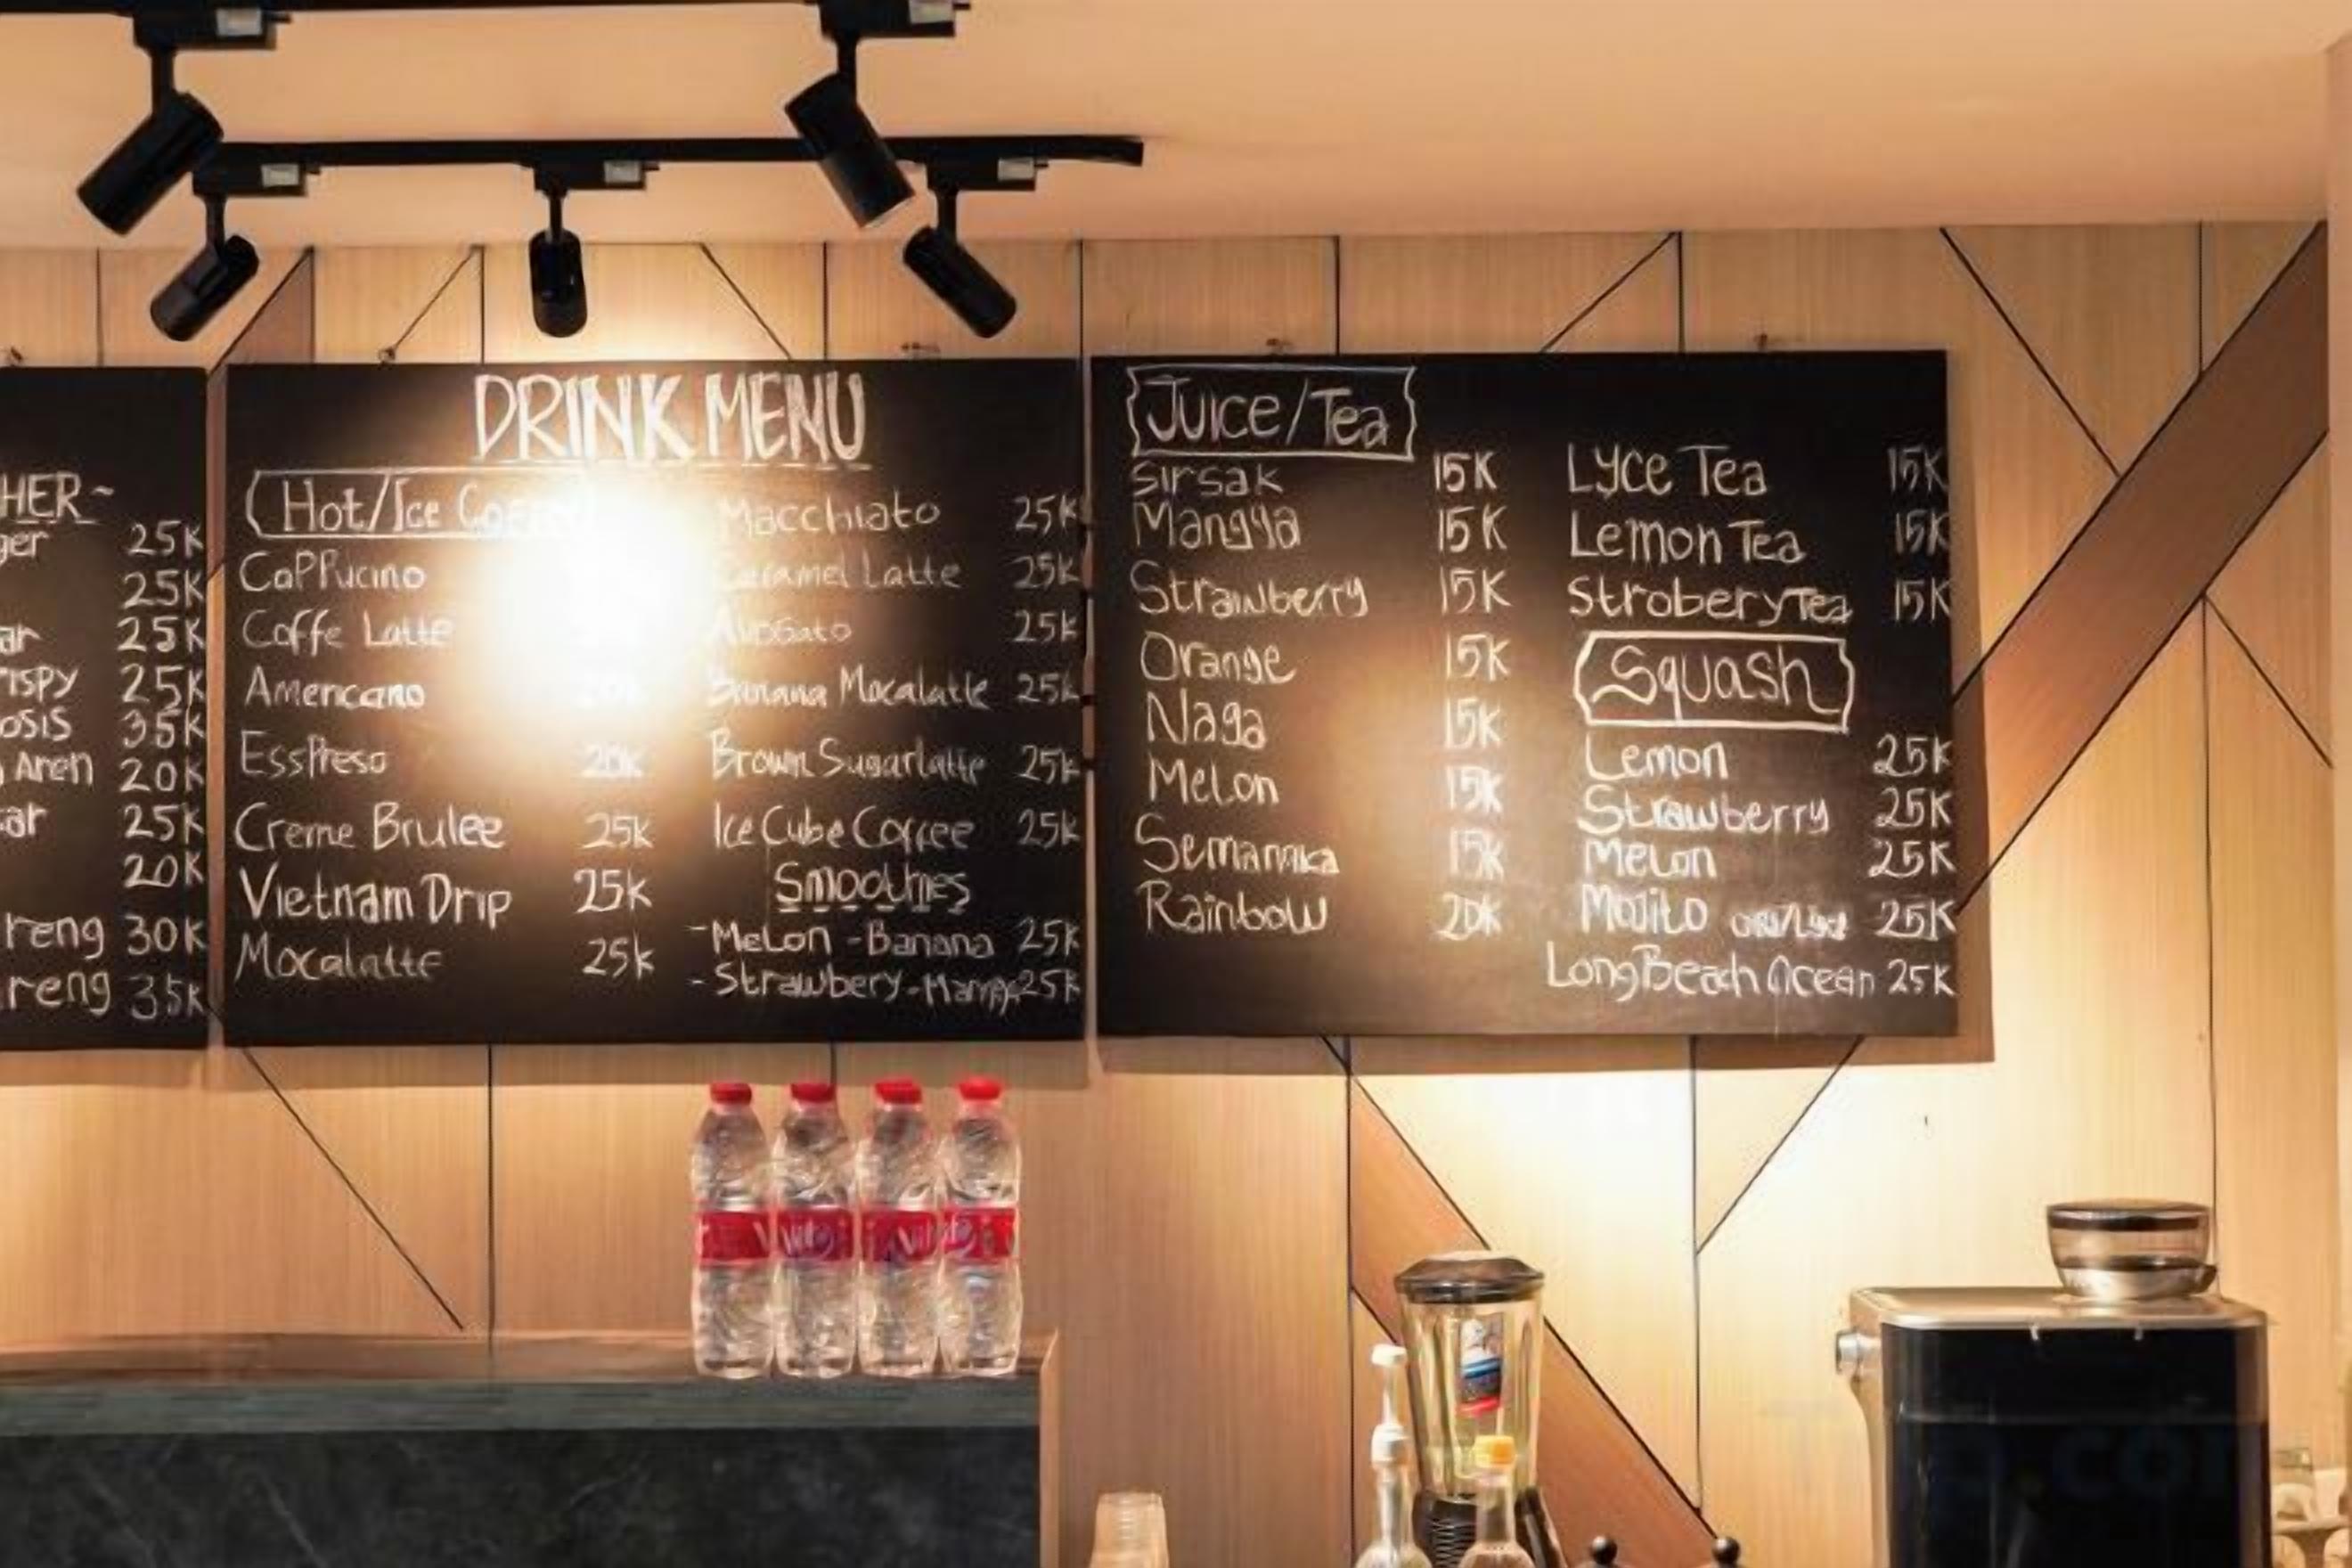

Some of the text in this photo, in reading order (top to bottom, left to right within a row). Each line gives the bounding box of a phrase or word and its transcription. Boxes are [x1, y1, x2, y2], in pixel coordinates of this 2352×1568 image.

[473, 371, 869, 461] DRINK MENU
[1433, 451, 1498, 492] 15K
[1677, 445, 1768, 496] Tea
[126, 519, 203, 558] 25K
[1439, 504, 1507, 552] 15K
[1571, 510, 1722, 567] Lemon
[1728, 519, 1809, 564] Tea
[122, 569, 203, 608] 25K
[1440, 567, 1513, 614] 15K
[117, 617, 204, 653] 25K
[1140, 632, 1511, 684] Orange 15K
[120, 664, 204, 710] 25K
[1591, 645, 1841, 723] Squash
[1147, 688, 1268, 751] Naga
[120, 757, 204, 792] 20K
[1586, 734, 1728, 780] Lemon
[124, 803, 204, 844] 25K
[234, 802, 354, 852] Creme
[372, 802, 504, 849] Brulee
[1577, 784, 1951, 835] Strawberry 25K
[124, 851, 203, 888] 20K
[1868, 839, 1956, 878] 25K
[241, 862, 411, 924] Vietnam
[125, 914, 206, 954] 30K
[1875, 898, 1956, 942] 25K
